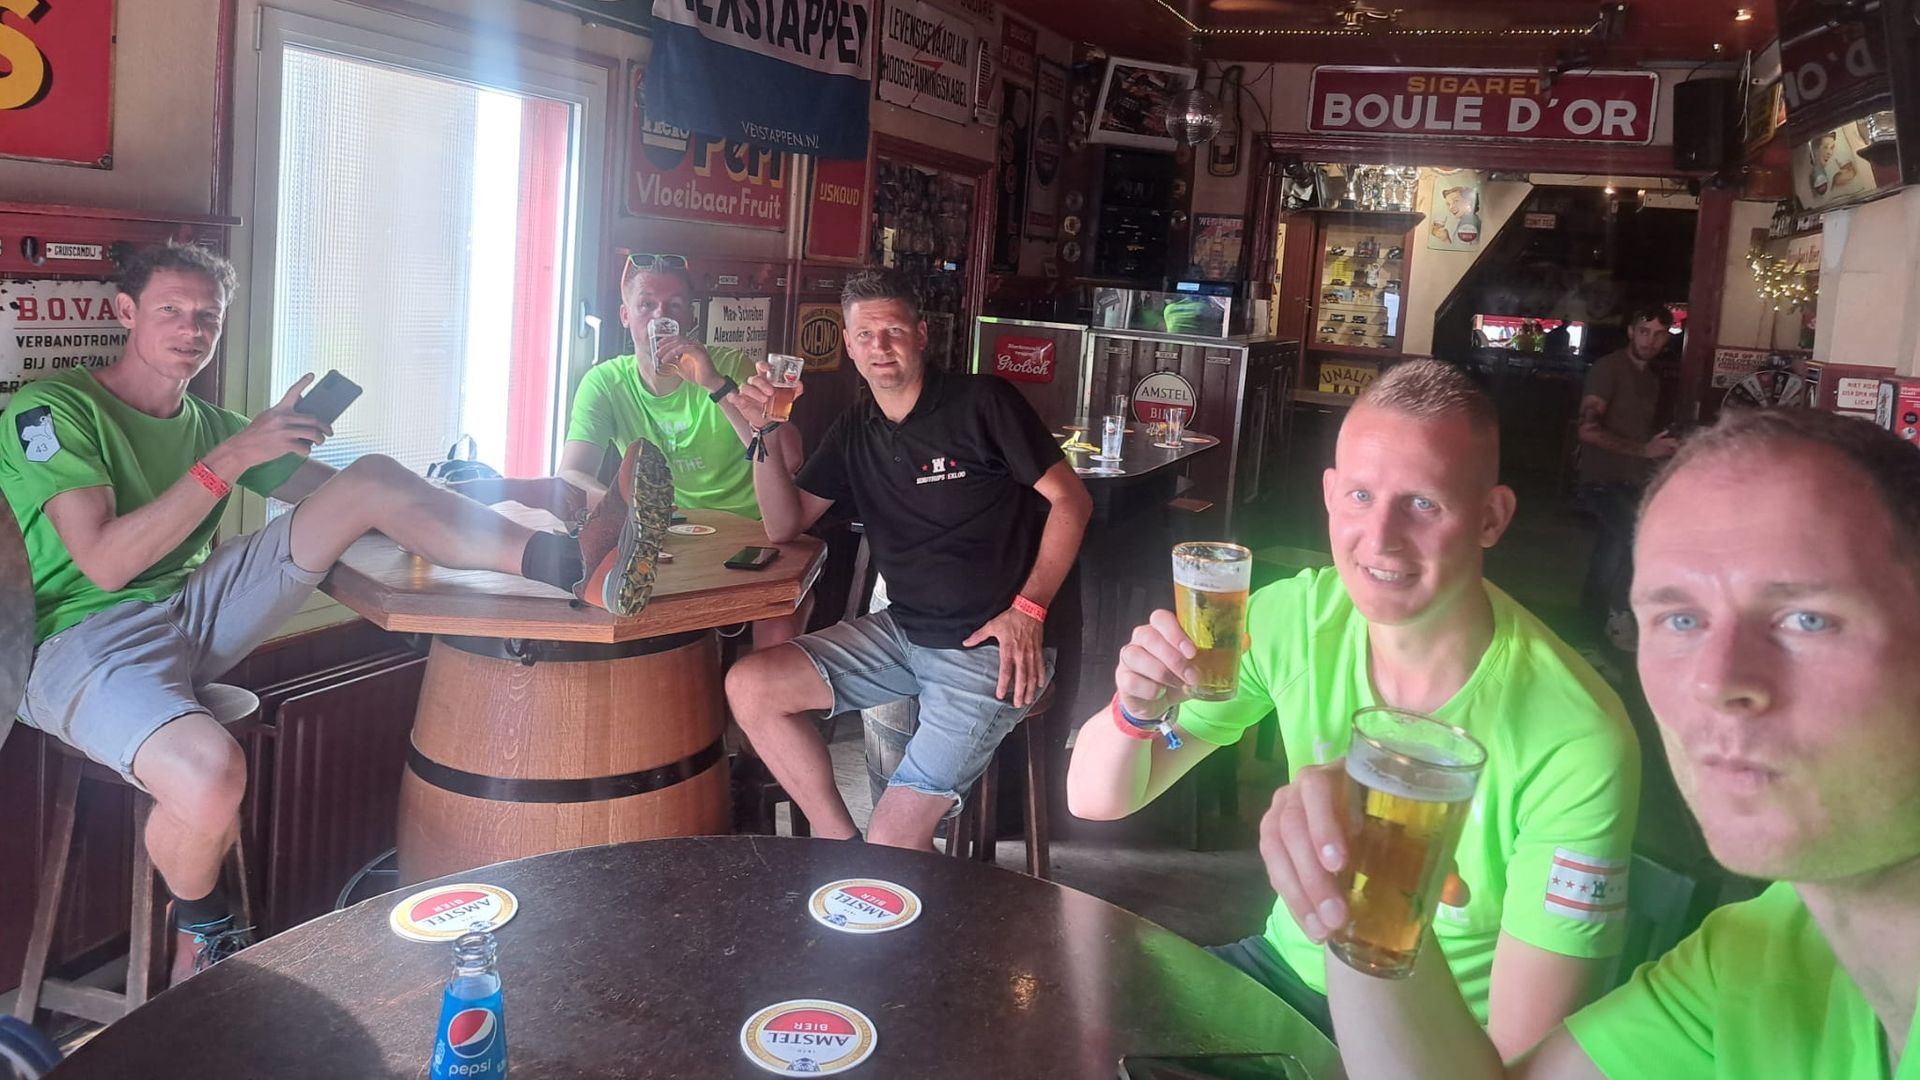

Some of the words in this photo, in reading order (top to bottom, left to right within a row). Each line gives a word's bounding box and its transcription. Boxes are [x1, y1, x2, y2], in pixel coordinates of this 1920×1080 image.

[888, 5, 969, 68] LEVENSGEVAARLIJK
[884, 53, 968, 107] HOOGSPANNINGSKABEL
[1322, 93, 1484, 131] BOULE
[1507, 97, 1638, 137] D'OR
[636, 171, 736, 214] Vloeibaar
[740, 187, 782, 220] Fruit
[819, 183, 859, 207] IJSKOUD
[714, 326, 745, 343] Alexander
[23, 357, 46, 370] BIJ
[52, 355, 118, 369] ONGEVAL
[997, 354, 1051, 376] Grolsch
[1140, 386, 1188, 401] AMSTEL
[833, 893, 892, 920] AMSTEL
[860, 892, 888, 908] BIER
[424, 897, 491, 926] AMSTEL
[793, 1022, 831, 1032] BIER
[768, 1031, 850, 1047] AMSTEL
[448, 1058, 492, 1078] pepsi
